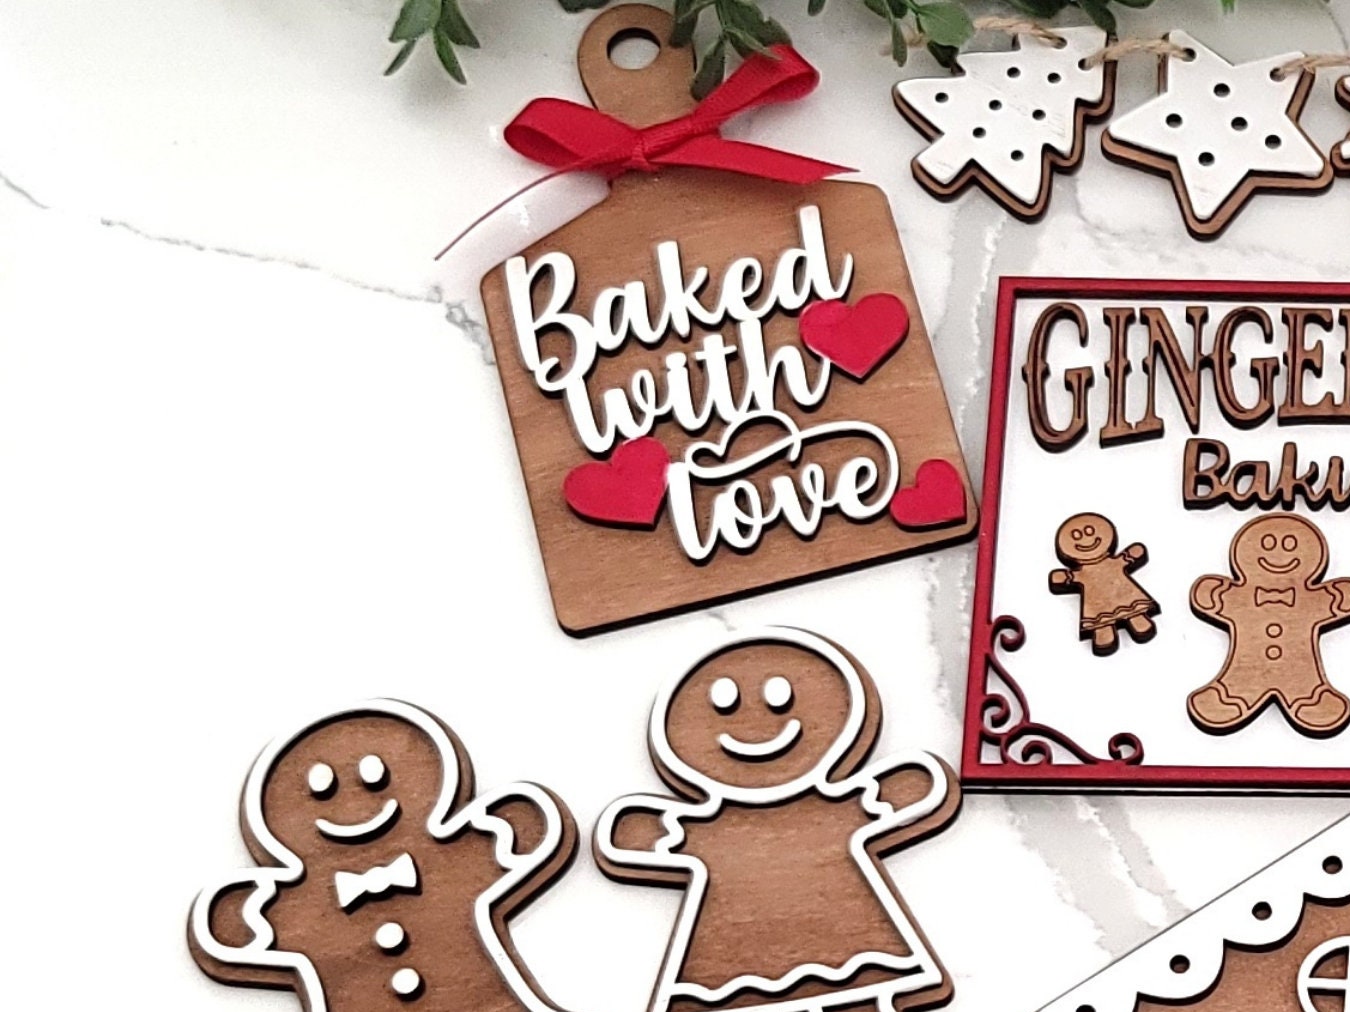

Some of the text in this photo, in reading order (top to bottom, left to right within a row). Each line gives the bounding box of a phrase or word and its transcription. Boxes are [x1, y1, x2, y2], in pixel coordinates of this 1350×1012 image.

[506, 205, 853, 391] Baked
[563, 318, 831, 452] with
[664, 410, 898, 559] love
